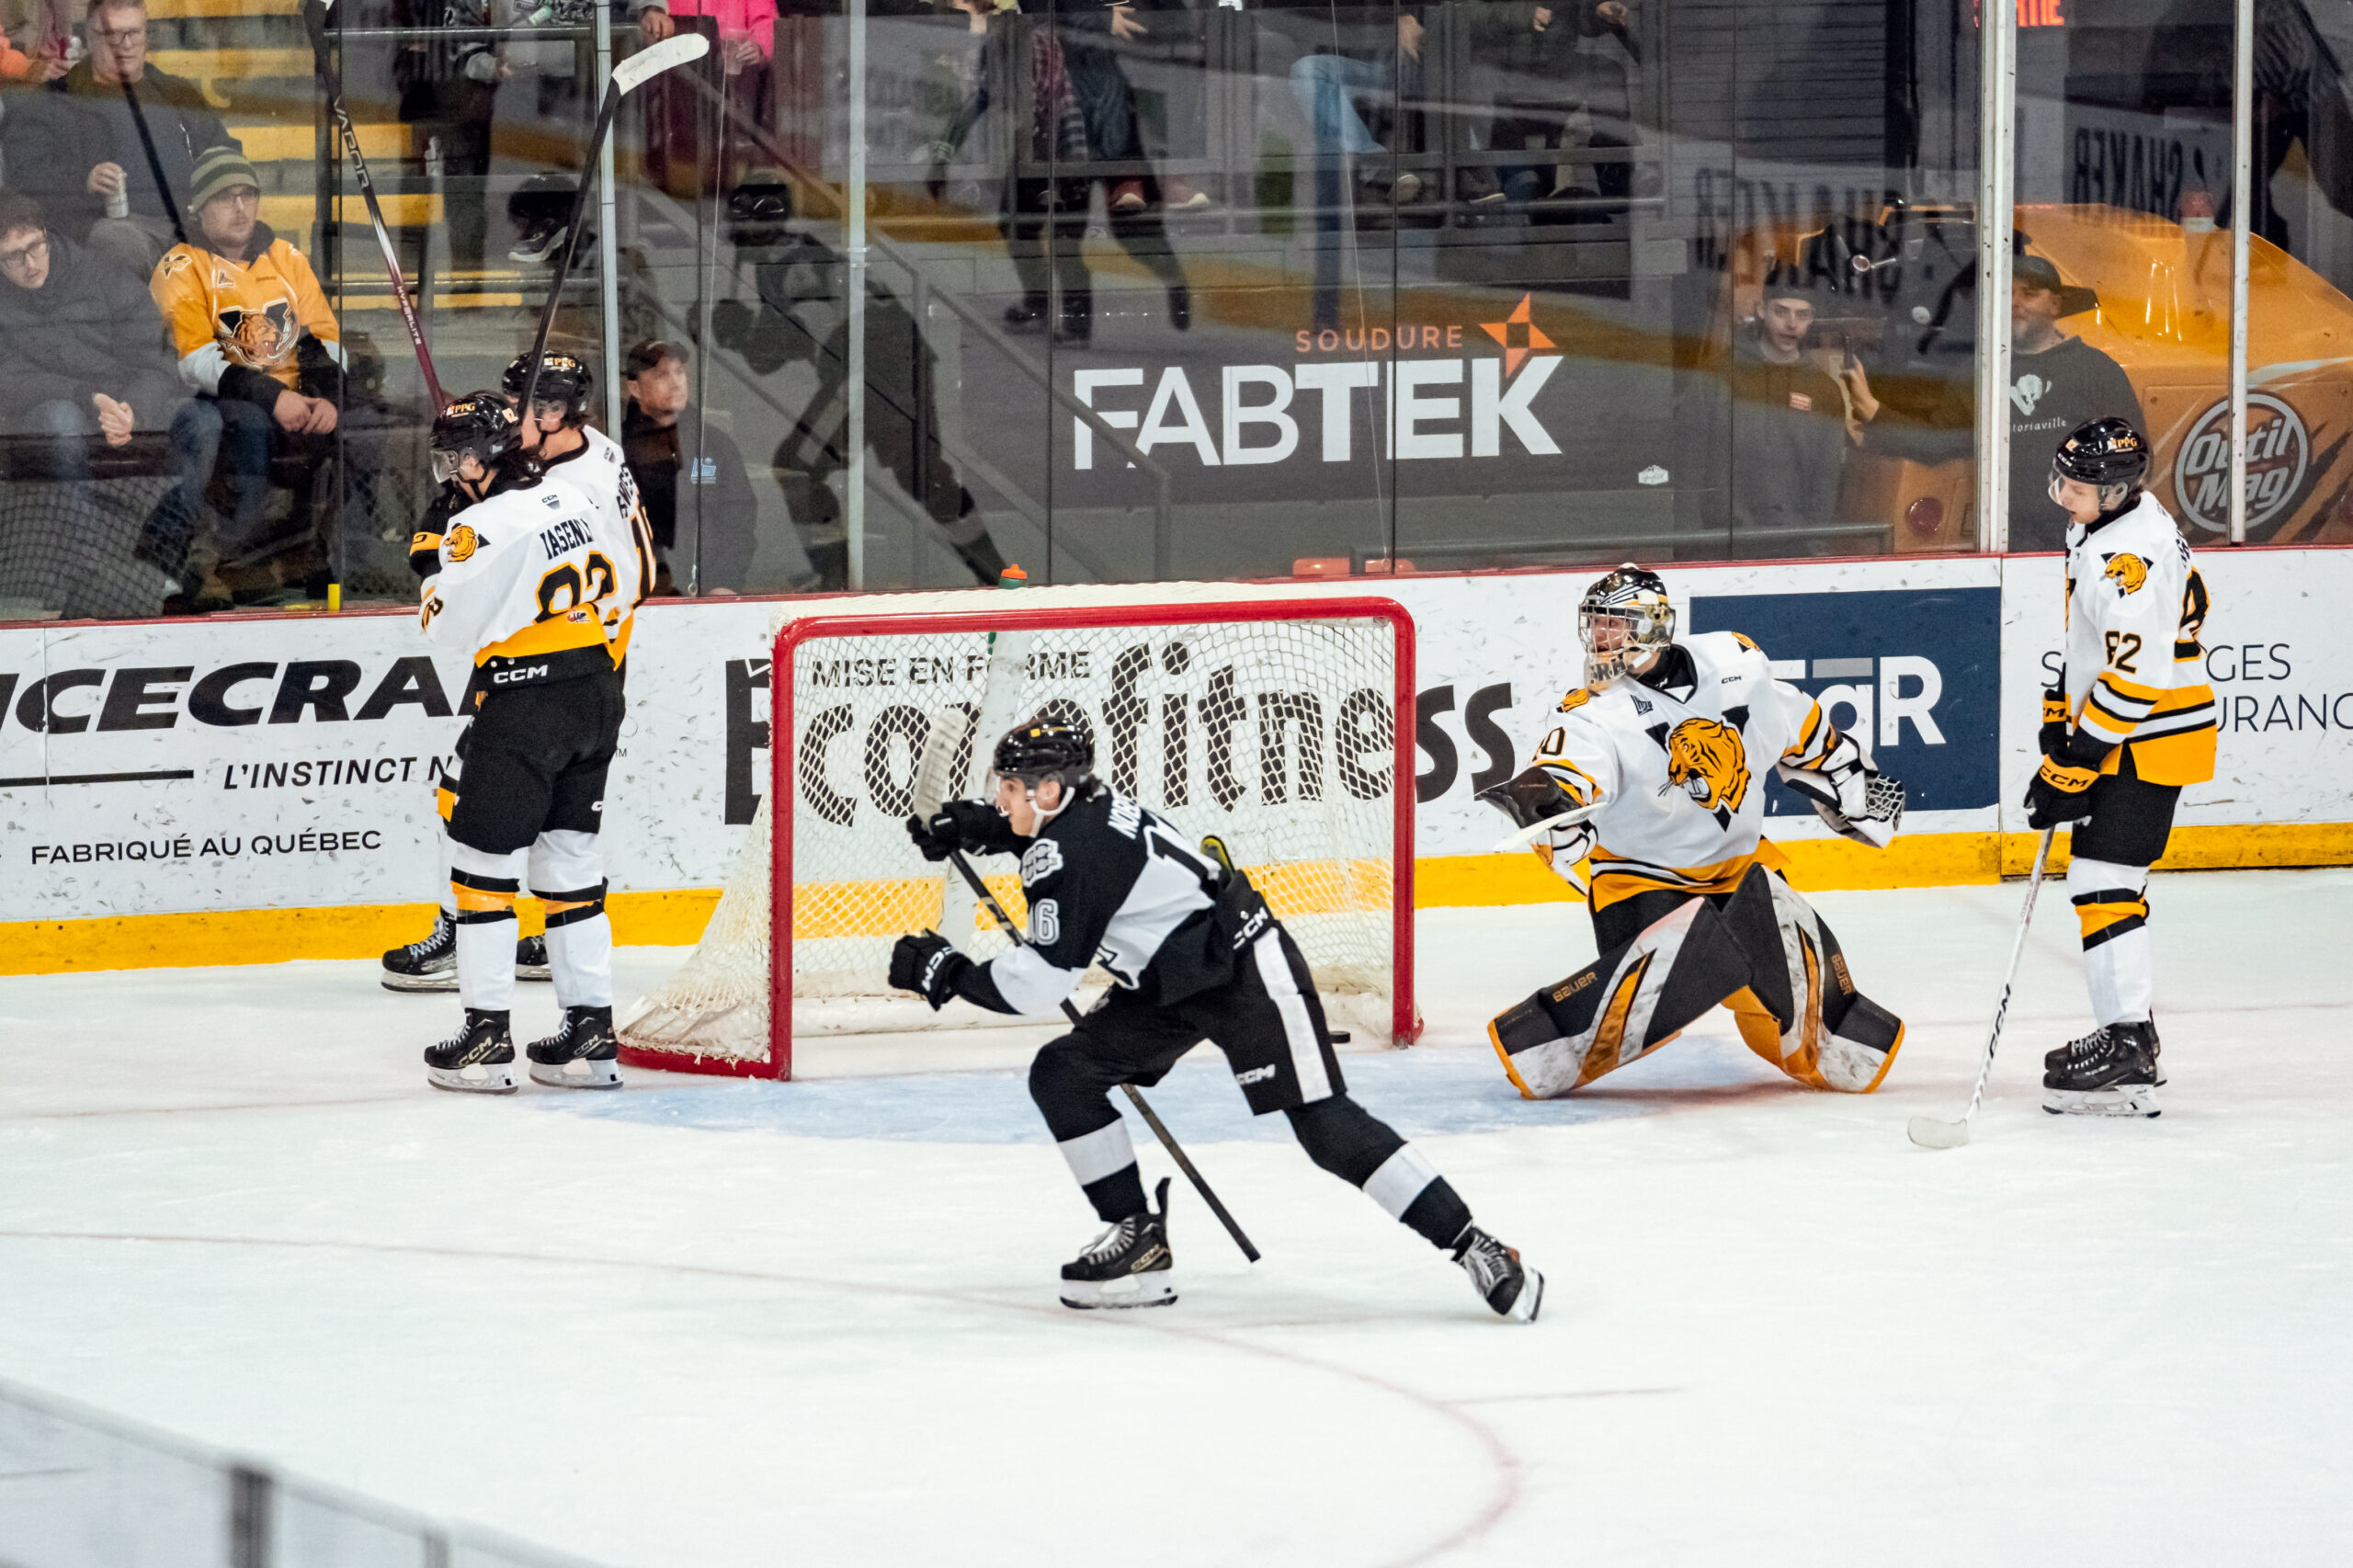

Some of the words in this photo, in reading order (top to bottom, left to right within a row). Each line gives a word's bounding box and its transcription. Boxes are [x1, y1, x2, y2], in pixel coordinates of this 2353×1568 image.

[334, 96, 369, 188] VAPOR
[1295, 325, 1463, 352] SOUDURE
[1074, 355, 1564, 470] FABTEK
[494, 664, 548, 684] CCM
[813, 658, 897, 689] MISE
[908, 655, 954, 685] EN
[2205, 642, 2291, 683] GES
[0, 655, 477, 734] CECRA
[1721, 676, 1742, 685] CCM
[223, 756, 417, 790] L'INSTINCT
[2039, 764, 2089, 788] CCM
[31, 833, 192, 865] FABRIQUÉ
[199, 837, 243, 858] AU
[250, 827, 382, 856] QUÉBEC
[1233, 906, 1268, 950] CCM
[1989, 983, 2011, 1060] CCM
[459, 1036, 494, 1066] CCM
[574, 1034, 598, 1057] CCM
